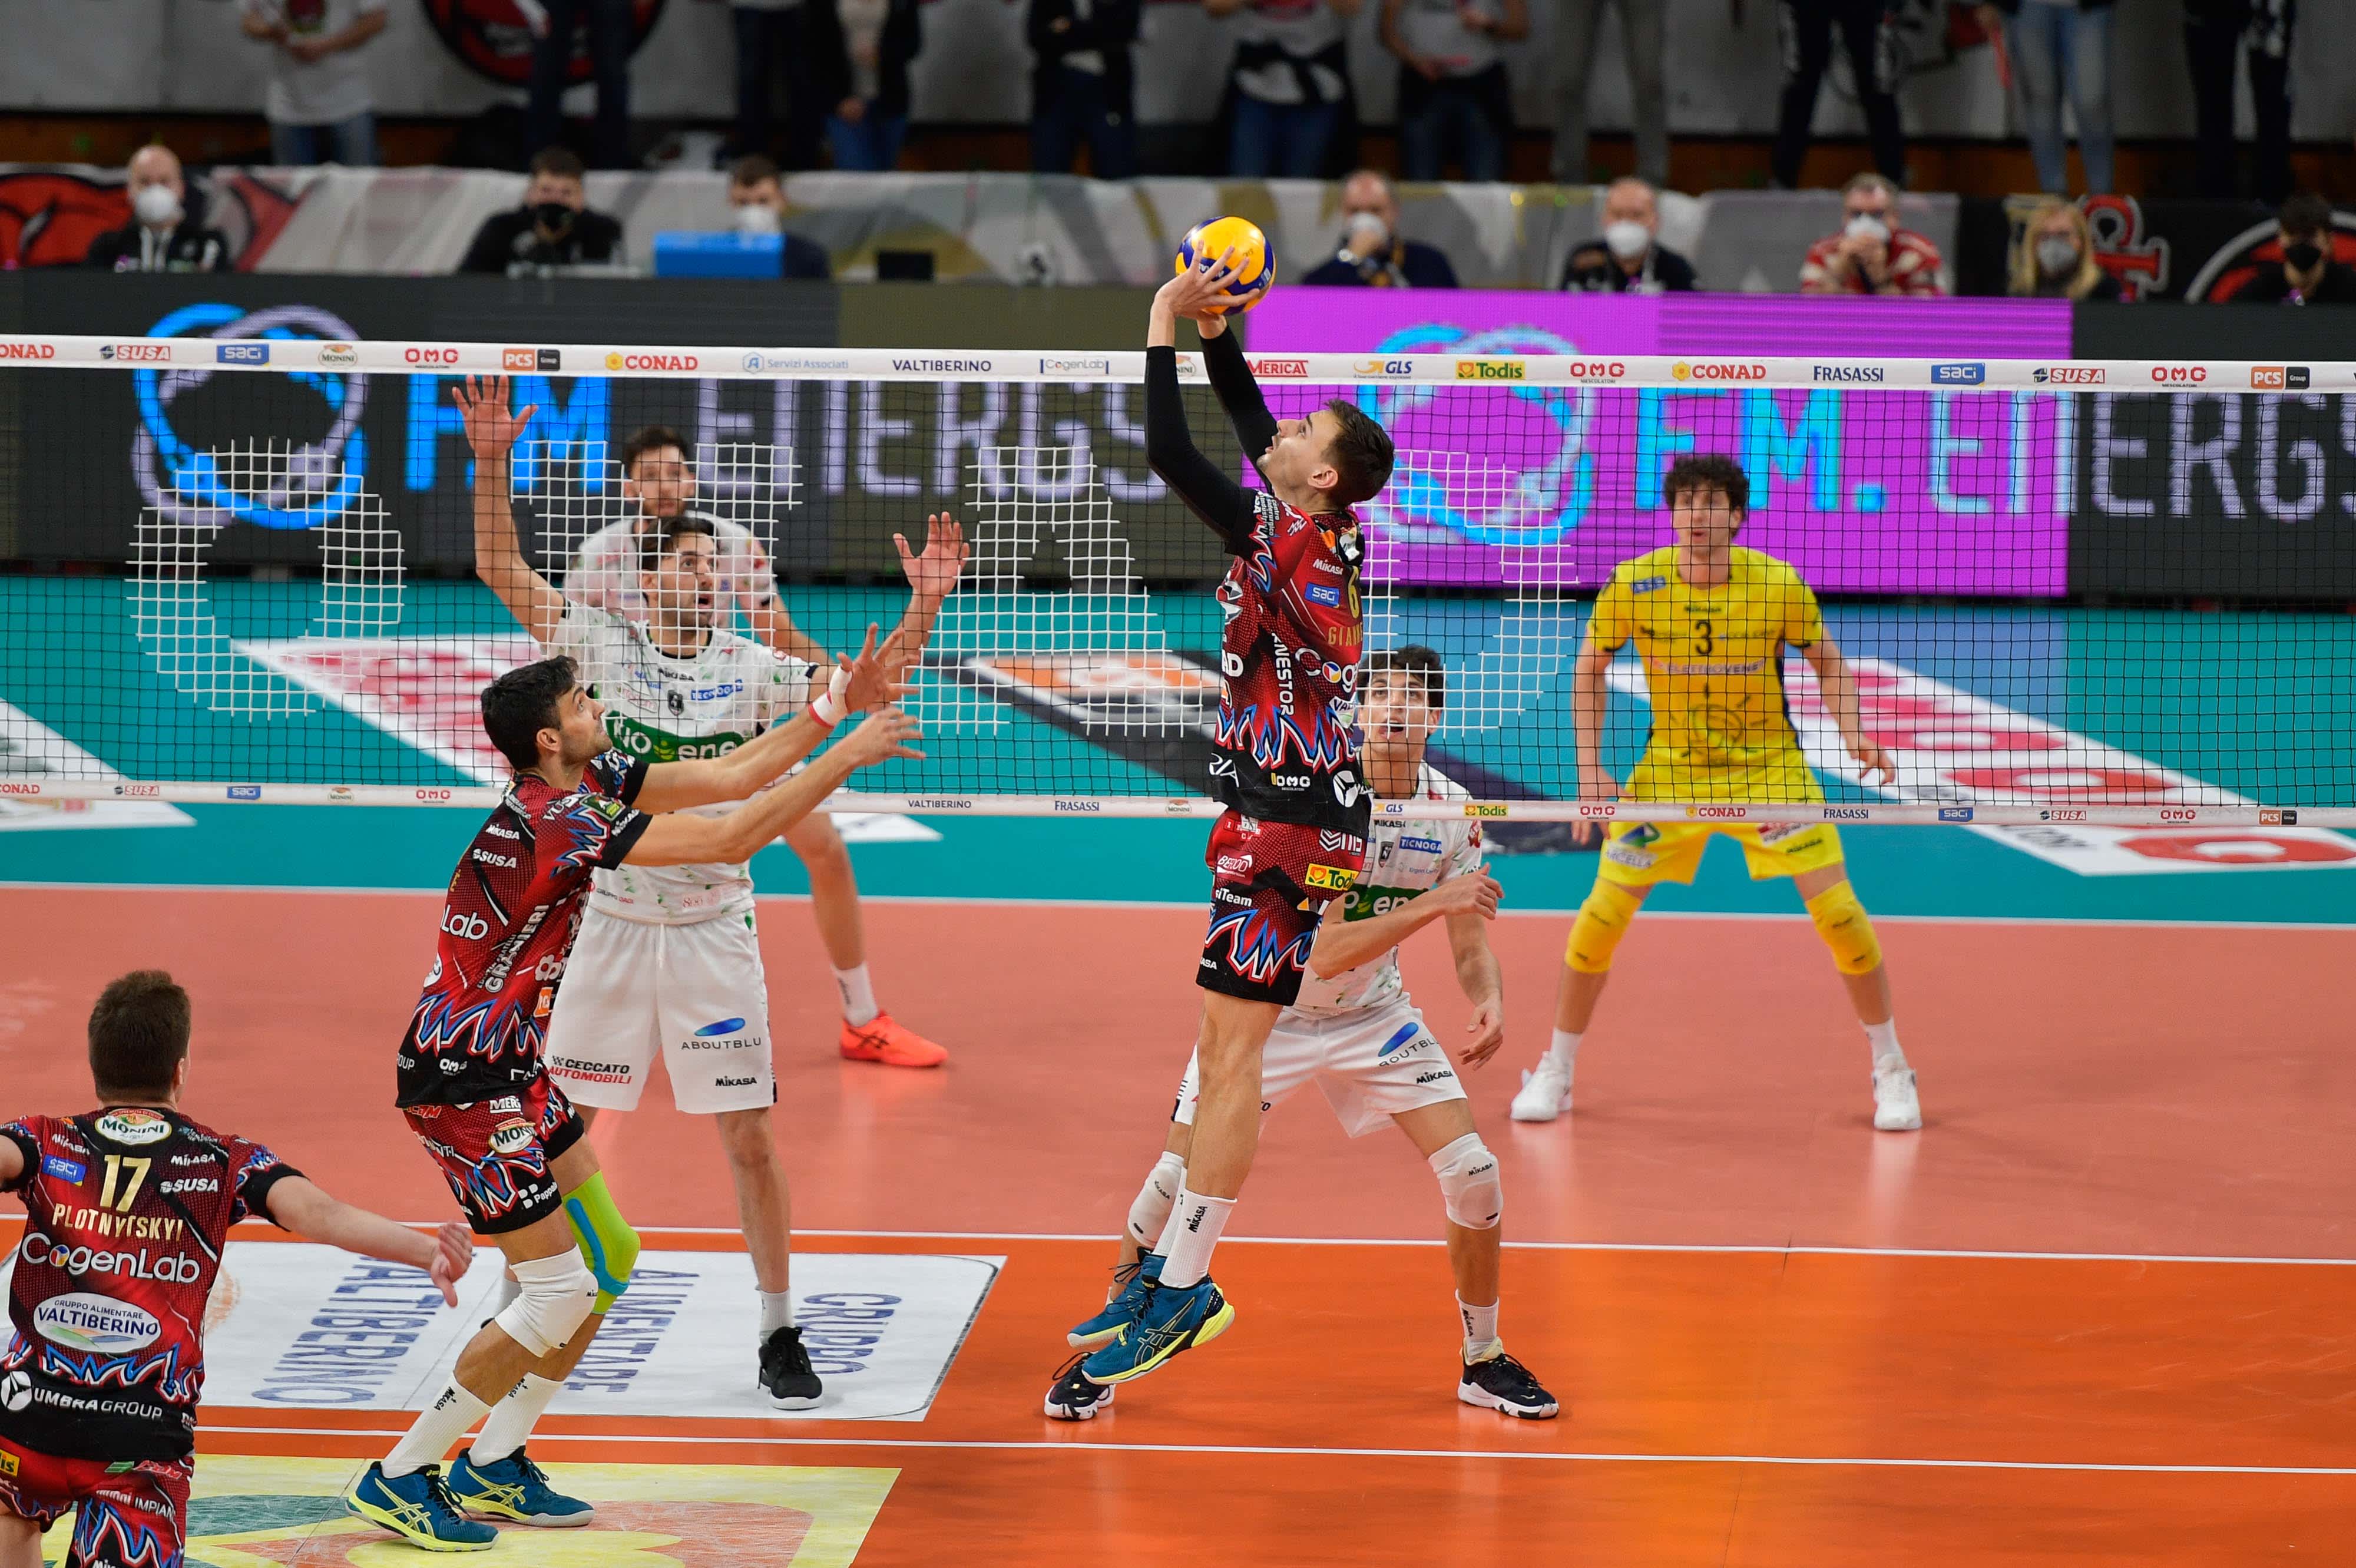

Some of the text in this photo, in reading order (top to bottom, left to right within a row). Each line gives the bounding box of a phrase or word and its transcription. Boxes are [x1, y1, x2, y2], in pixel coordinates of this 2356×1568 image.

[118, 345, 170, 360] SUSA
[322, 352, 355, 363] MONINI
[405, 348, 458, 363] OMG
[505, 353, 533, 367] PCS
[625, 355, 699, 371] CONAD
[767, 357, 849, 369] Servizi Associati
[892, 359, 992, 372] VALTIBERINO
[1045, 358, 1105, 371] CogenLab
[1385, 360, 1412, 374] GLS
[1476, 362, 1523, 379] Todis
[1570, 362, 1625, 378] OMG
[1692, 364, 1767, 379] CONAD
[1813, 366, 1884, 382] FRASASSI
[2051, 369, 2105, 383] SUSA
[2152, 367, 2206, 382] OMG
[2254, 371, 2282, 385] PCS
[1695, 619, 1713, 656] 3
[125, 786, 159, 796] SUSA
[416, 790, 451, 800] OMG
[908, 799, 972, 809] VALTIBERINO
[1054, 800, 1100, 812] FRASASSI
[1385, 804, 1403, 813] GLS
[1477, 805, 1508, 817] Todis
[1580, 806, 1616, 816] OMG
[1699, 807, 1746, 818] CONAD
[1824, 808, 1869, 819] FRASASSI
[2051, 810, 2086, 821] SUSA
[2160, 810, 2196, 821] OMG
[2261, 813, 2279, 823] PCS
[681, 1036, 762, 1051] ABOUTBLU
[565, 1058, 630, 1074] CECCATO
[549, 1066, 632, 1085] AUTOMOBILI
[101, 1118, 165, 1134] MONINI
[100, 1154, 152, 1213] 17
[21, 1232, 200, 1284] CogenLab
[54, 1299, 144, 1320] GRUPPO ALIMENTARE
[37, 1306, 158, 1337] VALTIBERINO
